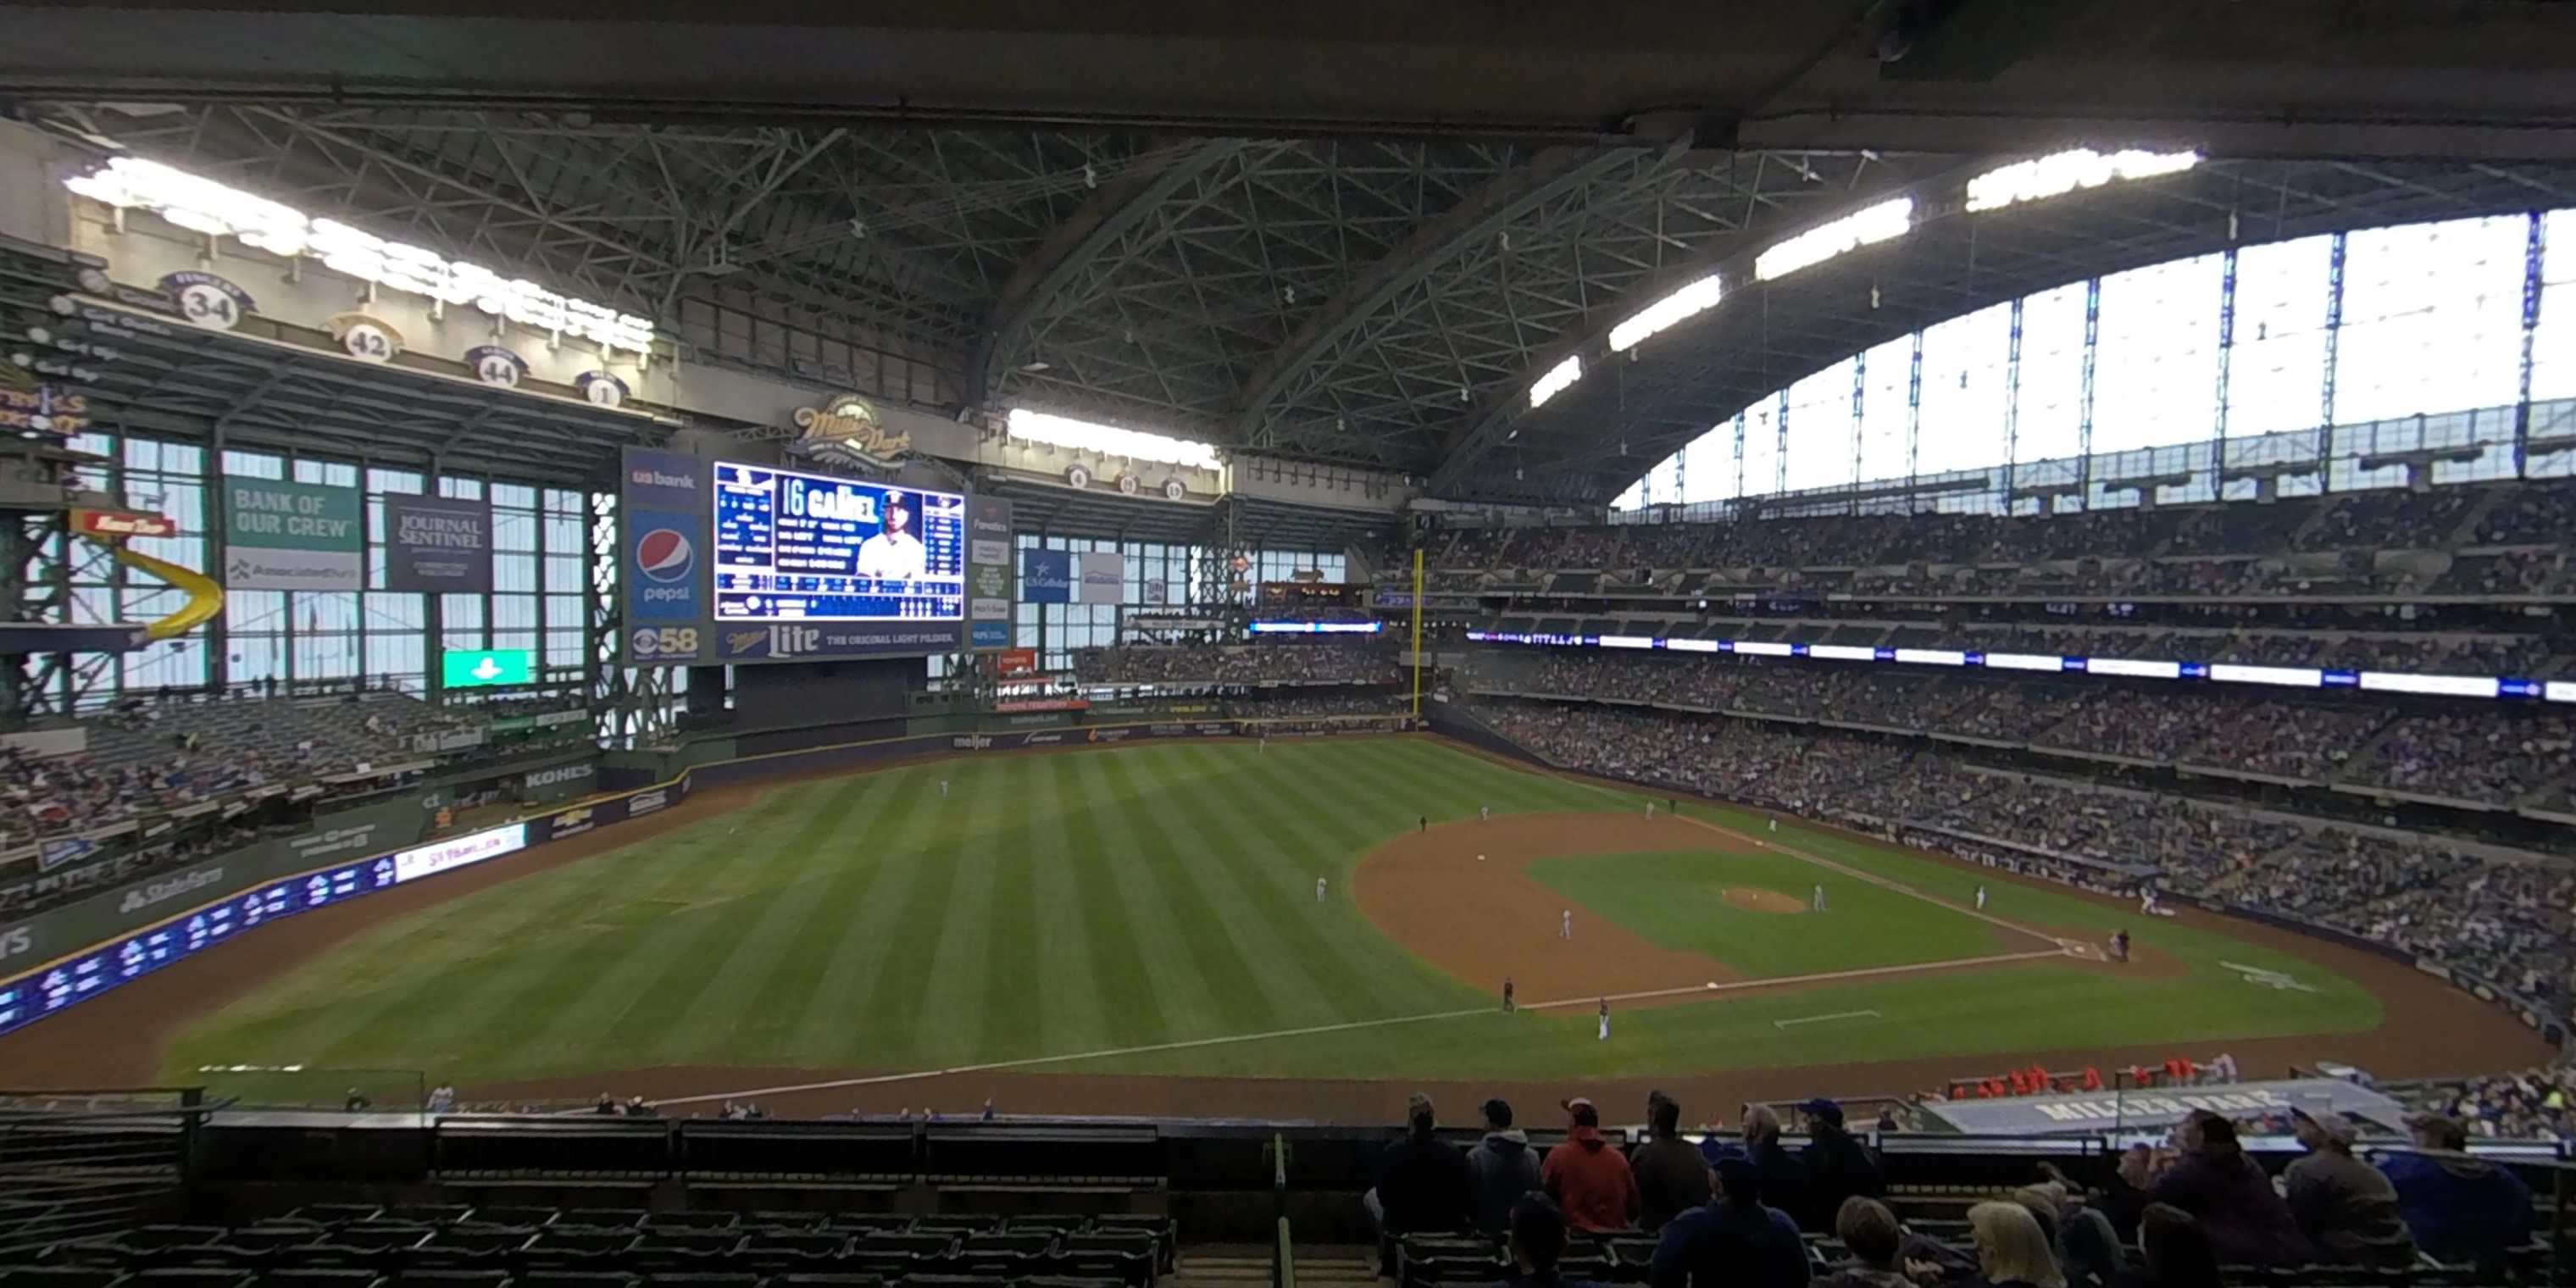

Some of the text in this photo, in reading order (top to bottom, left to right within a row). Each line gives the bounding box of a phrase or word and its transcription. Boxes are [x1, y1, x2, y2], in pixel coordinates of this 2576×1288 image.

[189, 291, 231, 320] 34
[351, 331, 386, 356] 42
[485, 362, 513, 382] 44
[235, 489, 325, 515] BANK OF
[783, 478, 804, 516] 16
[236, 512, 347, 538] OUR CREW
[401, 515, 482, 535] JOURNAL
[398, 530, 483, 548] SENTINEL
[644, 586, 690, 602] pepsi
[658, 627, 698, 653] 58
[768, 625, 820, 658] Lite
[826, 636, 847, 646] THE
[953, 736, 992, 750] meijer
[2035, 1095, 2190, 1122] MILLER
